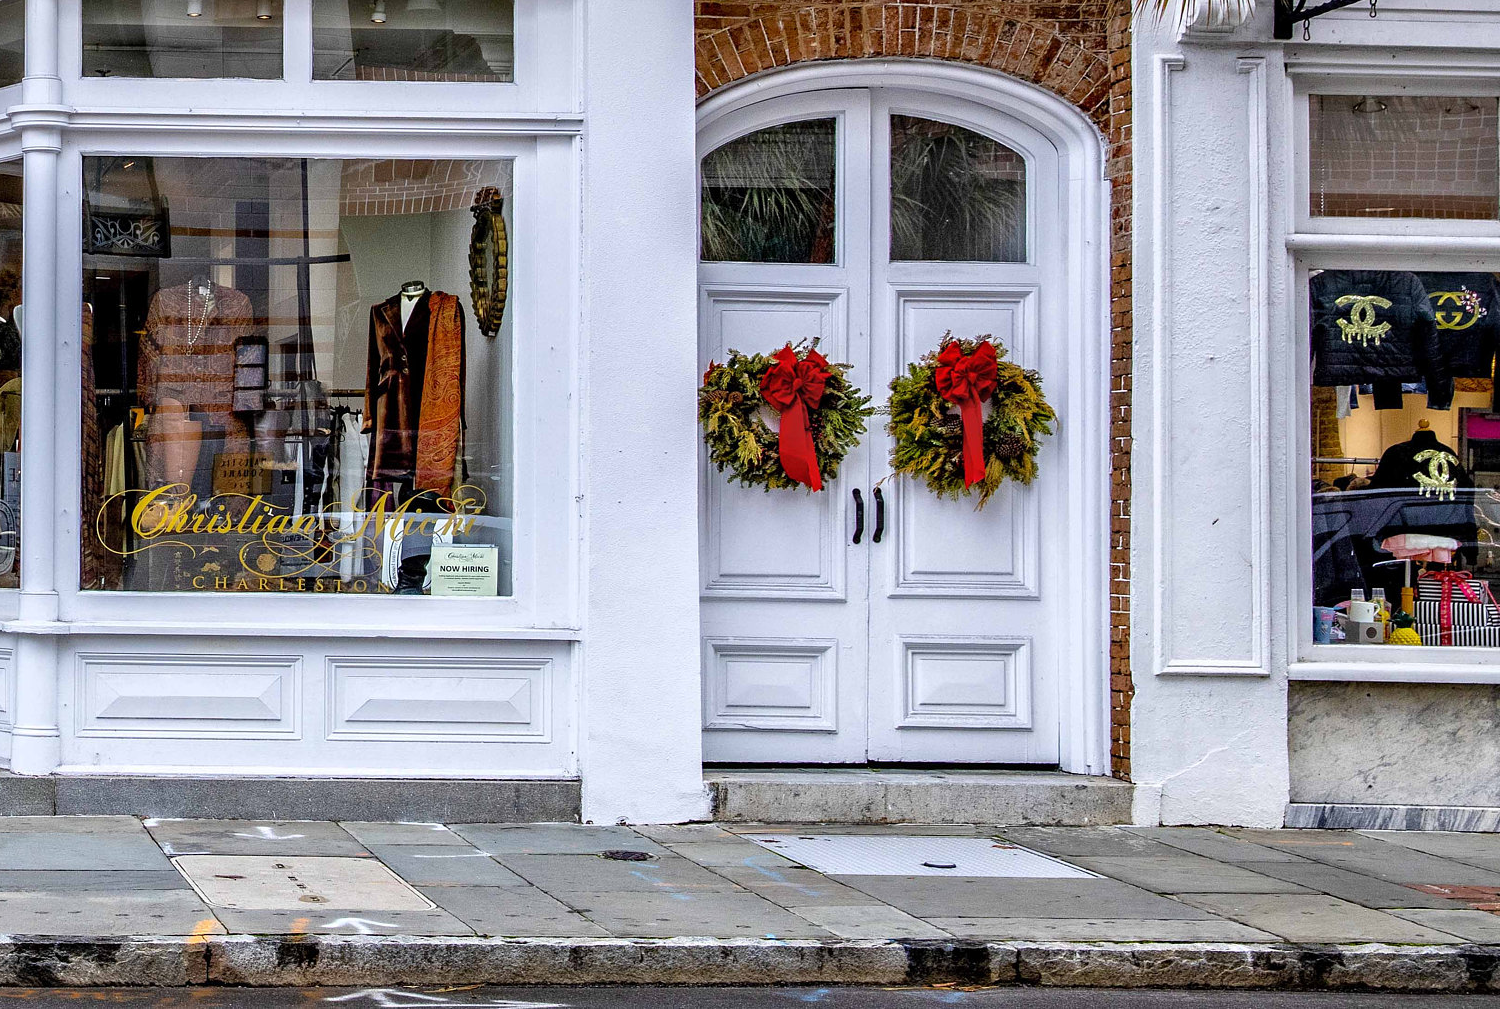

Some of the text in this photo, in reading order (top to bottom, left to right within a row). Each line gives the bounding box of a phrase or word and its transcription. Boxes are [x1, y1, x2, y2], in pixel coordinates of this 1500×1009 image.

[97, 483, 487, 555] Christian Michi
[462, 565, 489, 573] HIRING
[192, 576, 391, 592] CHARLESTON
